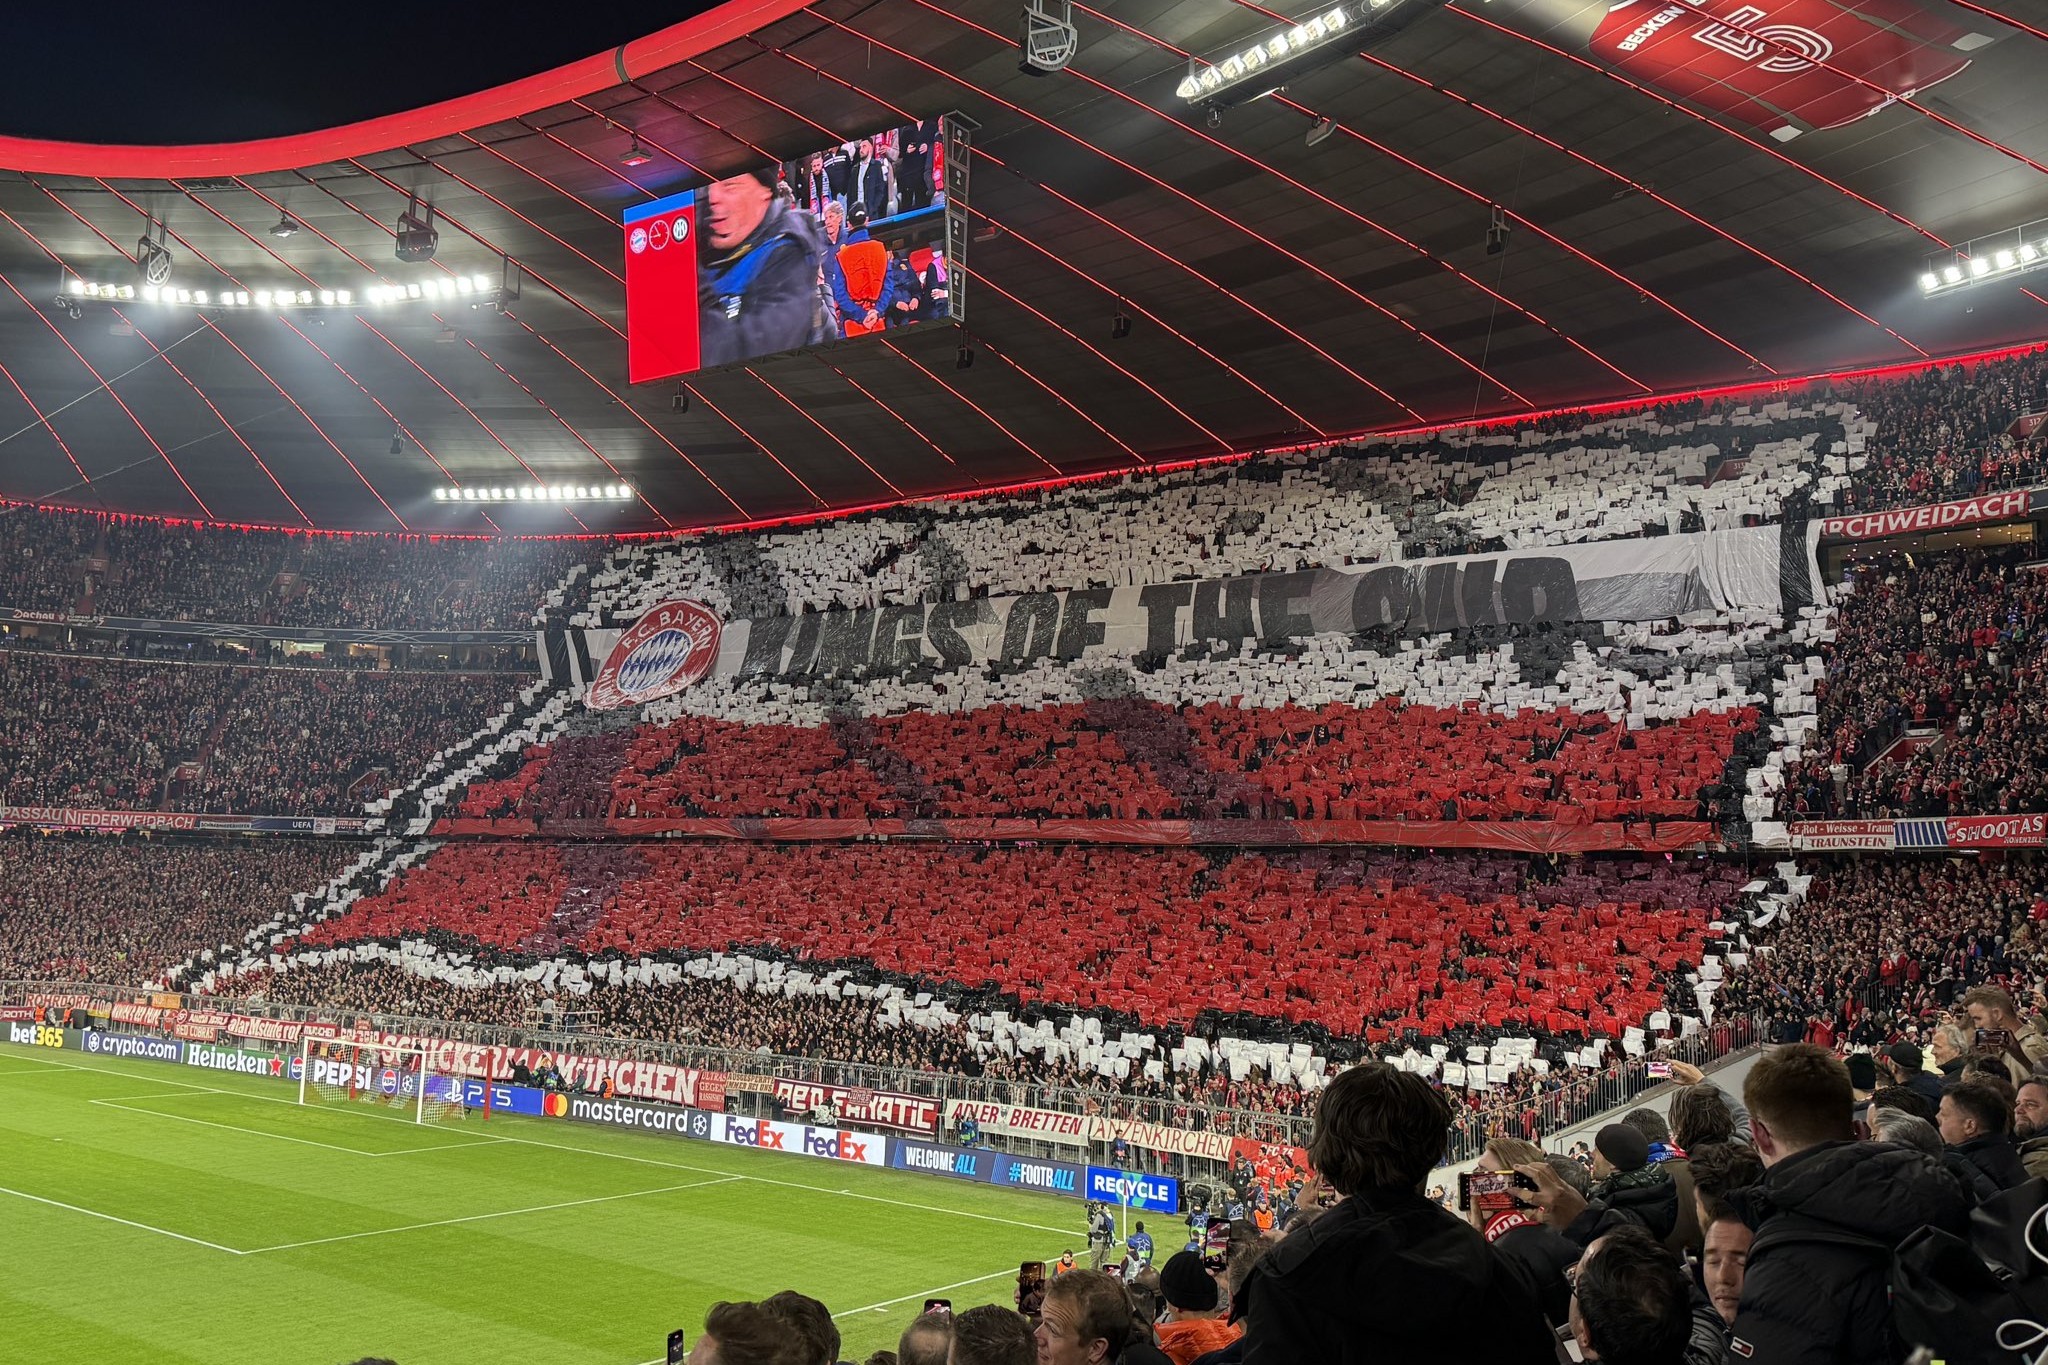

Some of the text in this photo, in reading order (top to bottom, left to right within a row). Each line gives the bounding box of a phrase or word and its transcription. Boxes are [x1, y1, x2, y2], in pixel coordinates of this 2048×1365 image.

[1617, 5, 1687, 51] BECKEN
[1000, 587, 1115, 664] OF
[1139, 569, 1317, 656] THE
[659, 610, 714, 652] BAYERN
[3, 806, 62, 820] PASSAU
[292, 821, 312, 829] UEFA
[1803, 824, 1818, 834] Rot
[1826, 823, 1858, 833] Weisse
[1811, 837, 1888, 848] TRAUNSTEIN
[1956, 815, 2044, 843] SHOOTAS
[3, 1010, 31, 1018] ROTH
[10, 1022, 64, 1048] bet365
[102, 1035, 177, 1060] crypto.com
[188, 1043, 267, 1075] Heineken
[314, 1059, 372, 1090] PEPSI
[700, 1082, 725, 1092] GEGEN
[701, 1071, 727, 1081] ULTRAS
[760, 1083, 773, 1092] UNS
[572, 1099, 688, 1132] mastercard
[1009, 1108, 1084, 1136] BRETTEN
[725, 1115, 785, 1150] FedEx
[803, 1126, 868, 1162] FedEx
[1092, 1117, 1230, 1159] ANZENKIRCHEN
[905, 1146, 977, 1176] WELCOME ALL
[1009, 1162, 1075, 1191] #FOOTBALL
[1094, 1175, 1169, 1202] RECYCLE
